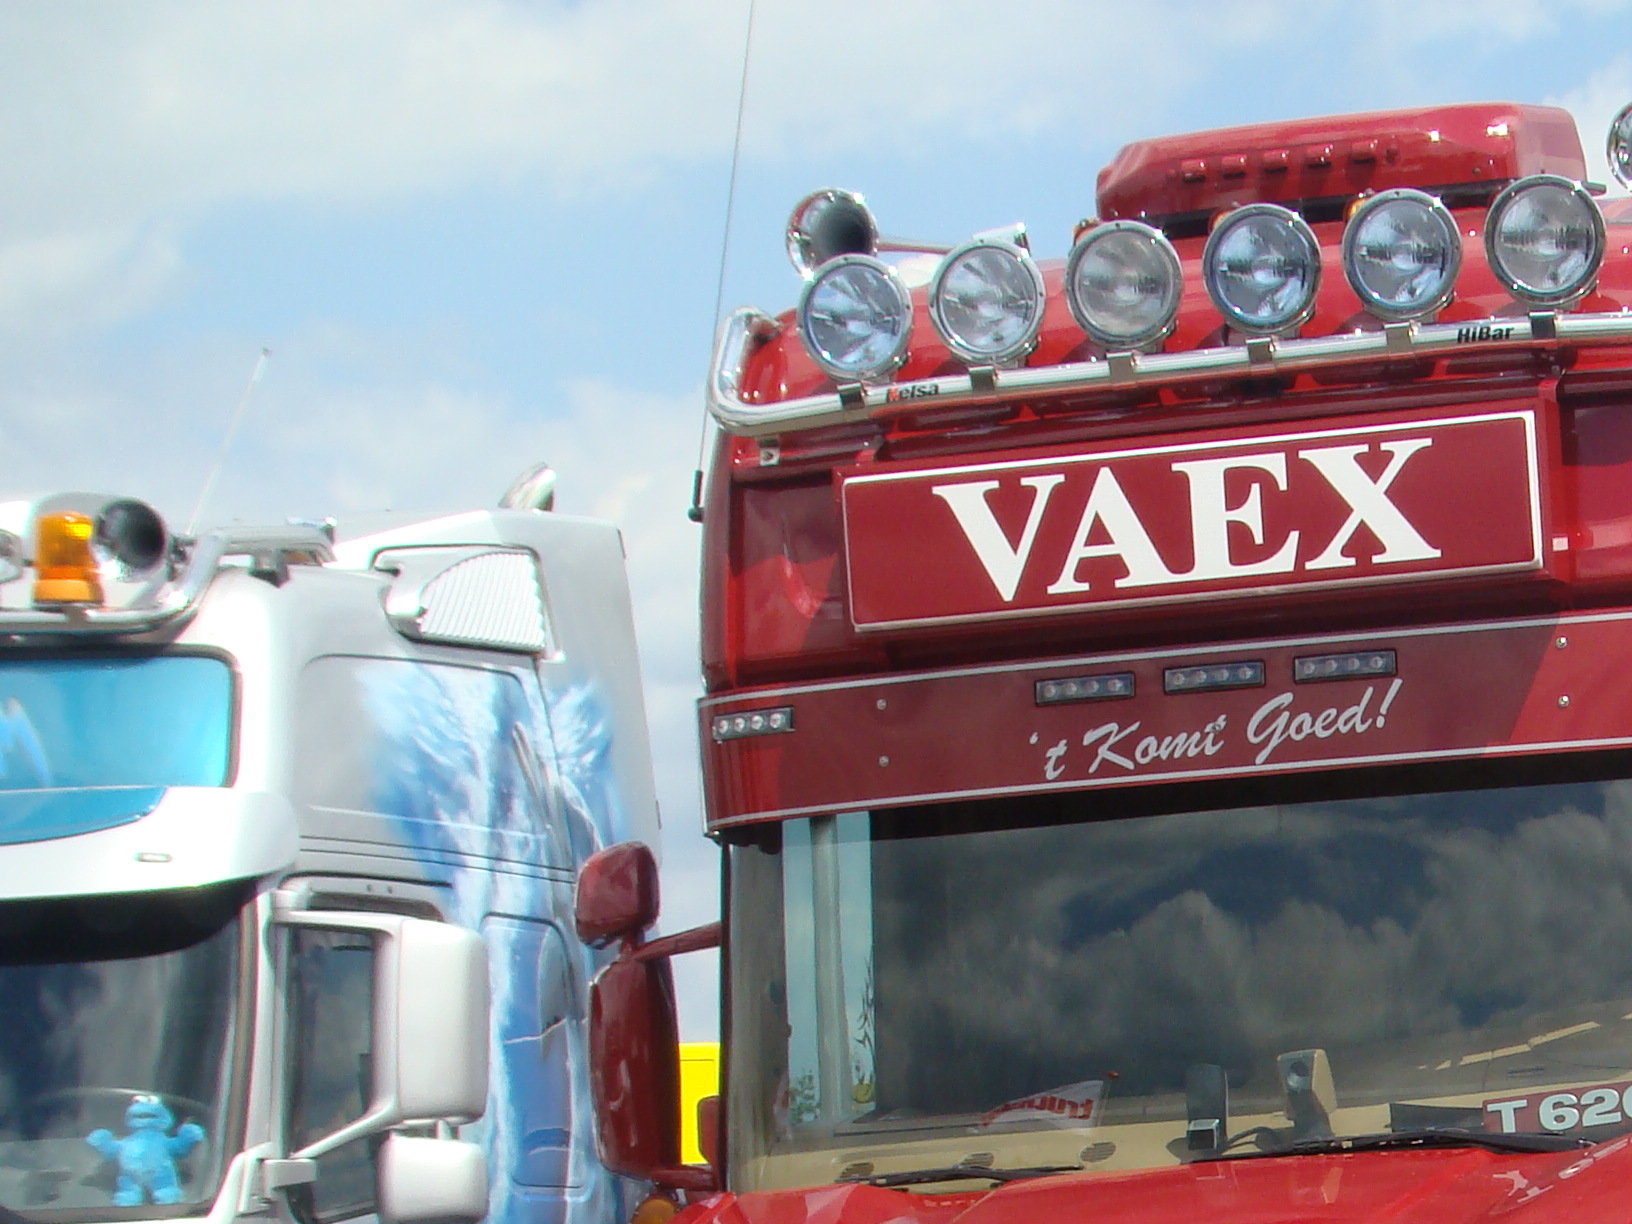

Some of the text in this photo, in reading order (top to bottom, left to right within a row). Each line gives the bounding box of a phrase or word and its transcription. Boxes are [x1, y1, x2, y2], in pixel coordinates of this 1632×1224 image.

[1456, 326, 1515, 343] HiBar
[932, 438, 1442, 602] VAEX
[1083, 715, 1227, 774] Komt
[1245, 679, 1404, 765] Goed!
[1486, 1099, 1528, 1133] T
